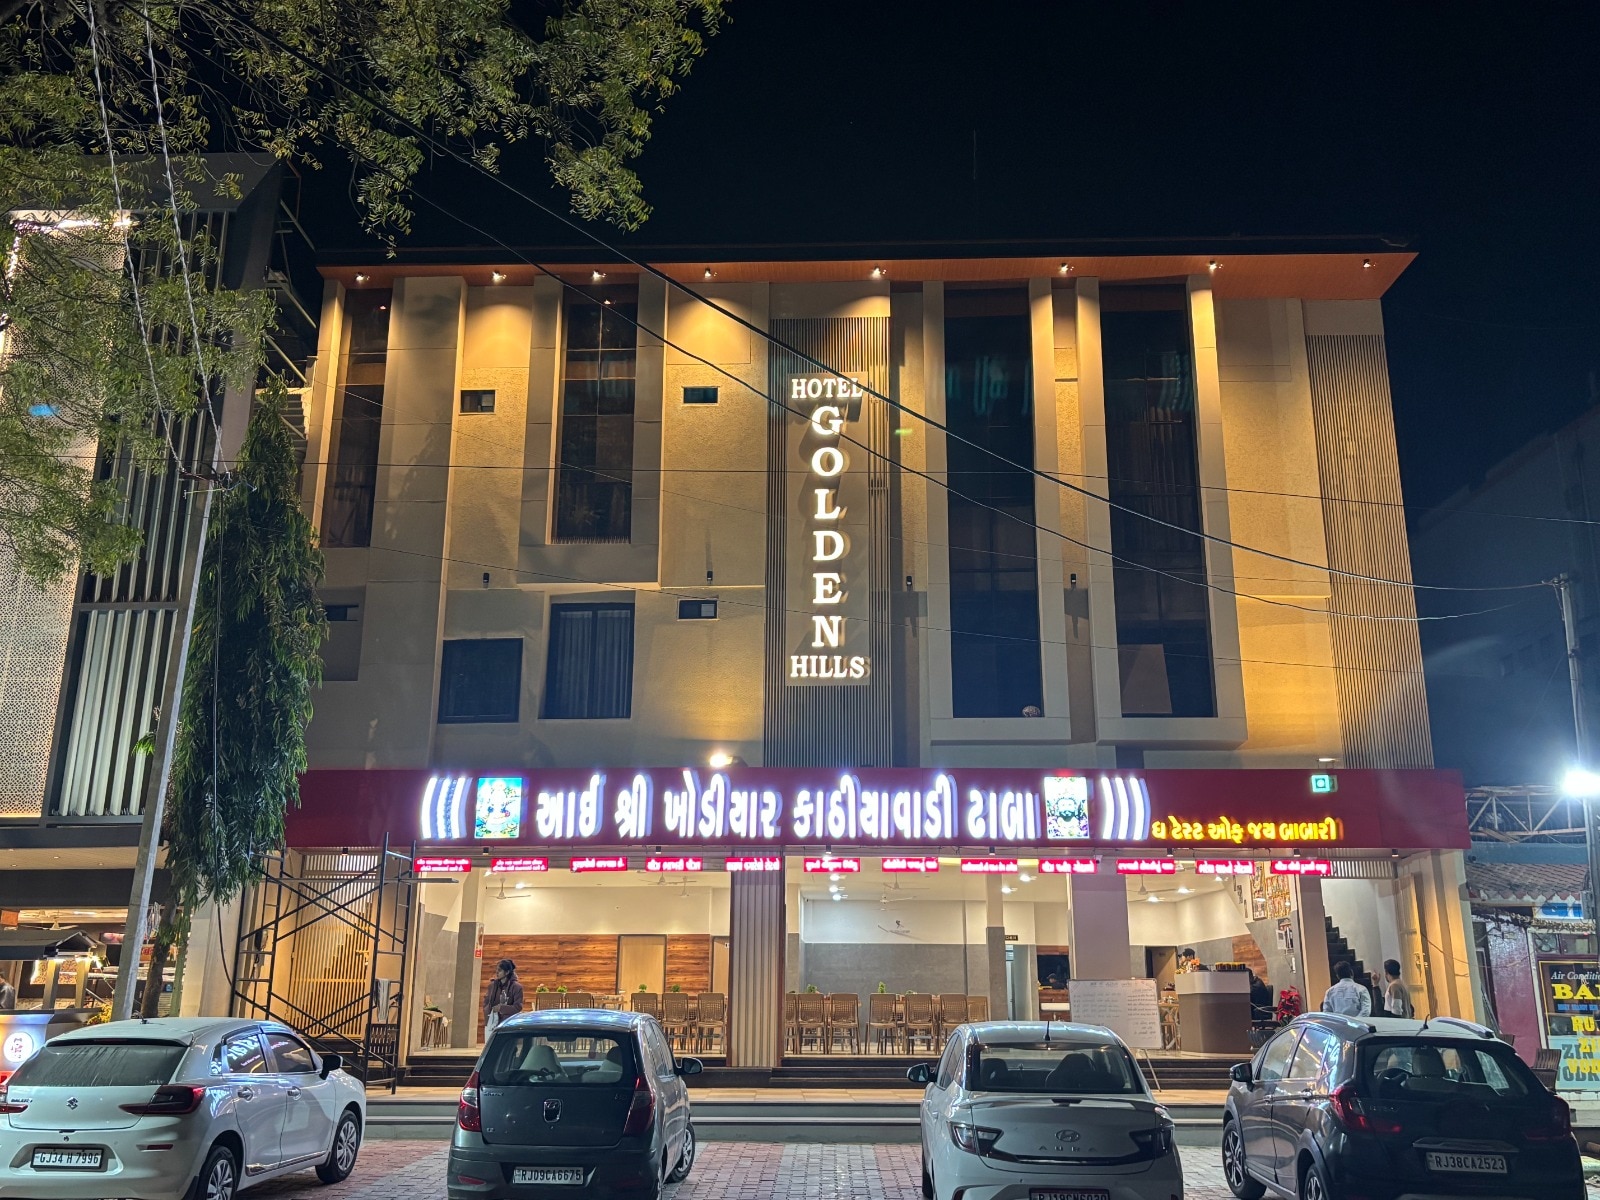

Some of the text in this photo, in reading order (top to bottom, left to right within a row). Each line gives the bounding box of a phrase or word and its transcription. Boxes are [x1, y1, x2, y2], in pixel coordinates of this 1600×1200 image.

[791, 378, 863, 399] HOTEL
[810, 405, 845, 648] GOLDEN
[790, 655, 866, 679] HILLS
[614, 774, 652, 838] શ્રી
[664, 770, 779, 838] ખોડીયાર
[793, 774, 954, 839] કાઠીયાવાડી
[1247, 822, 1276, 840] જય
[1551, 972, 1565, 980] Air
[40, 1153, 99, 1164] GJ34 H 7996
[1435, 1156, 1504, 1171] RJ38CA2523
[520, 1169, 581, 1181] RJ09CA6675
